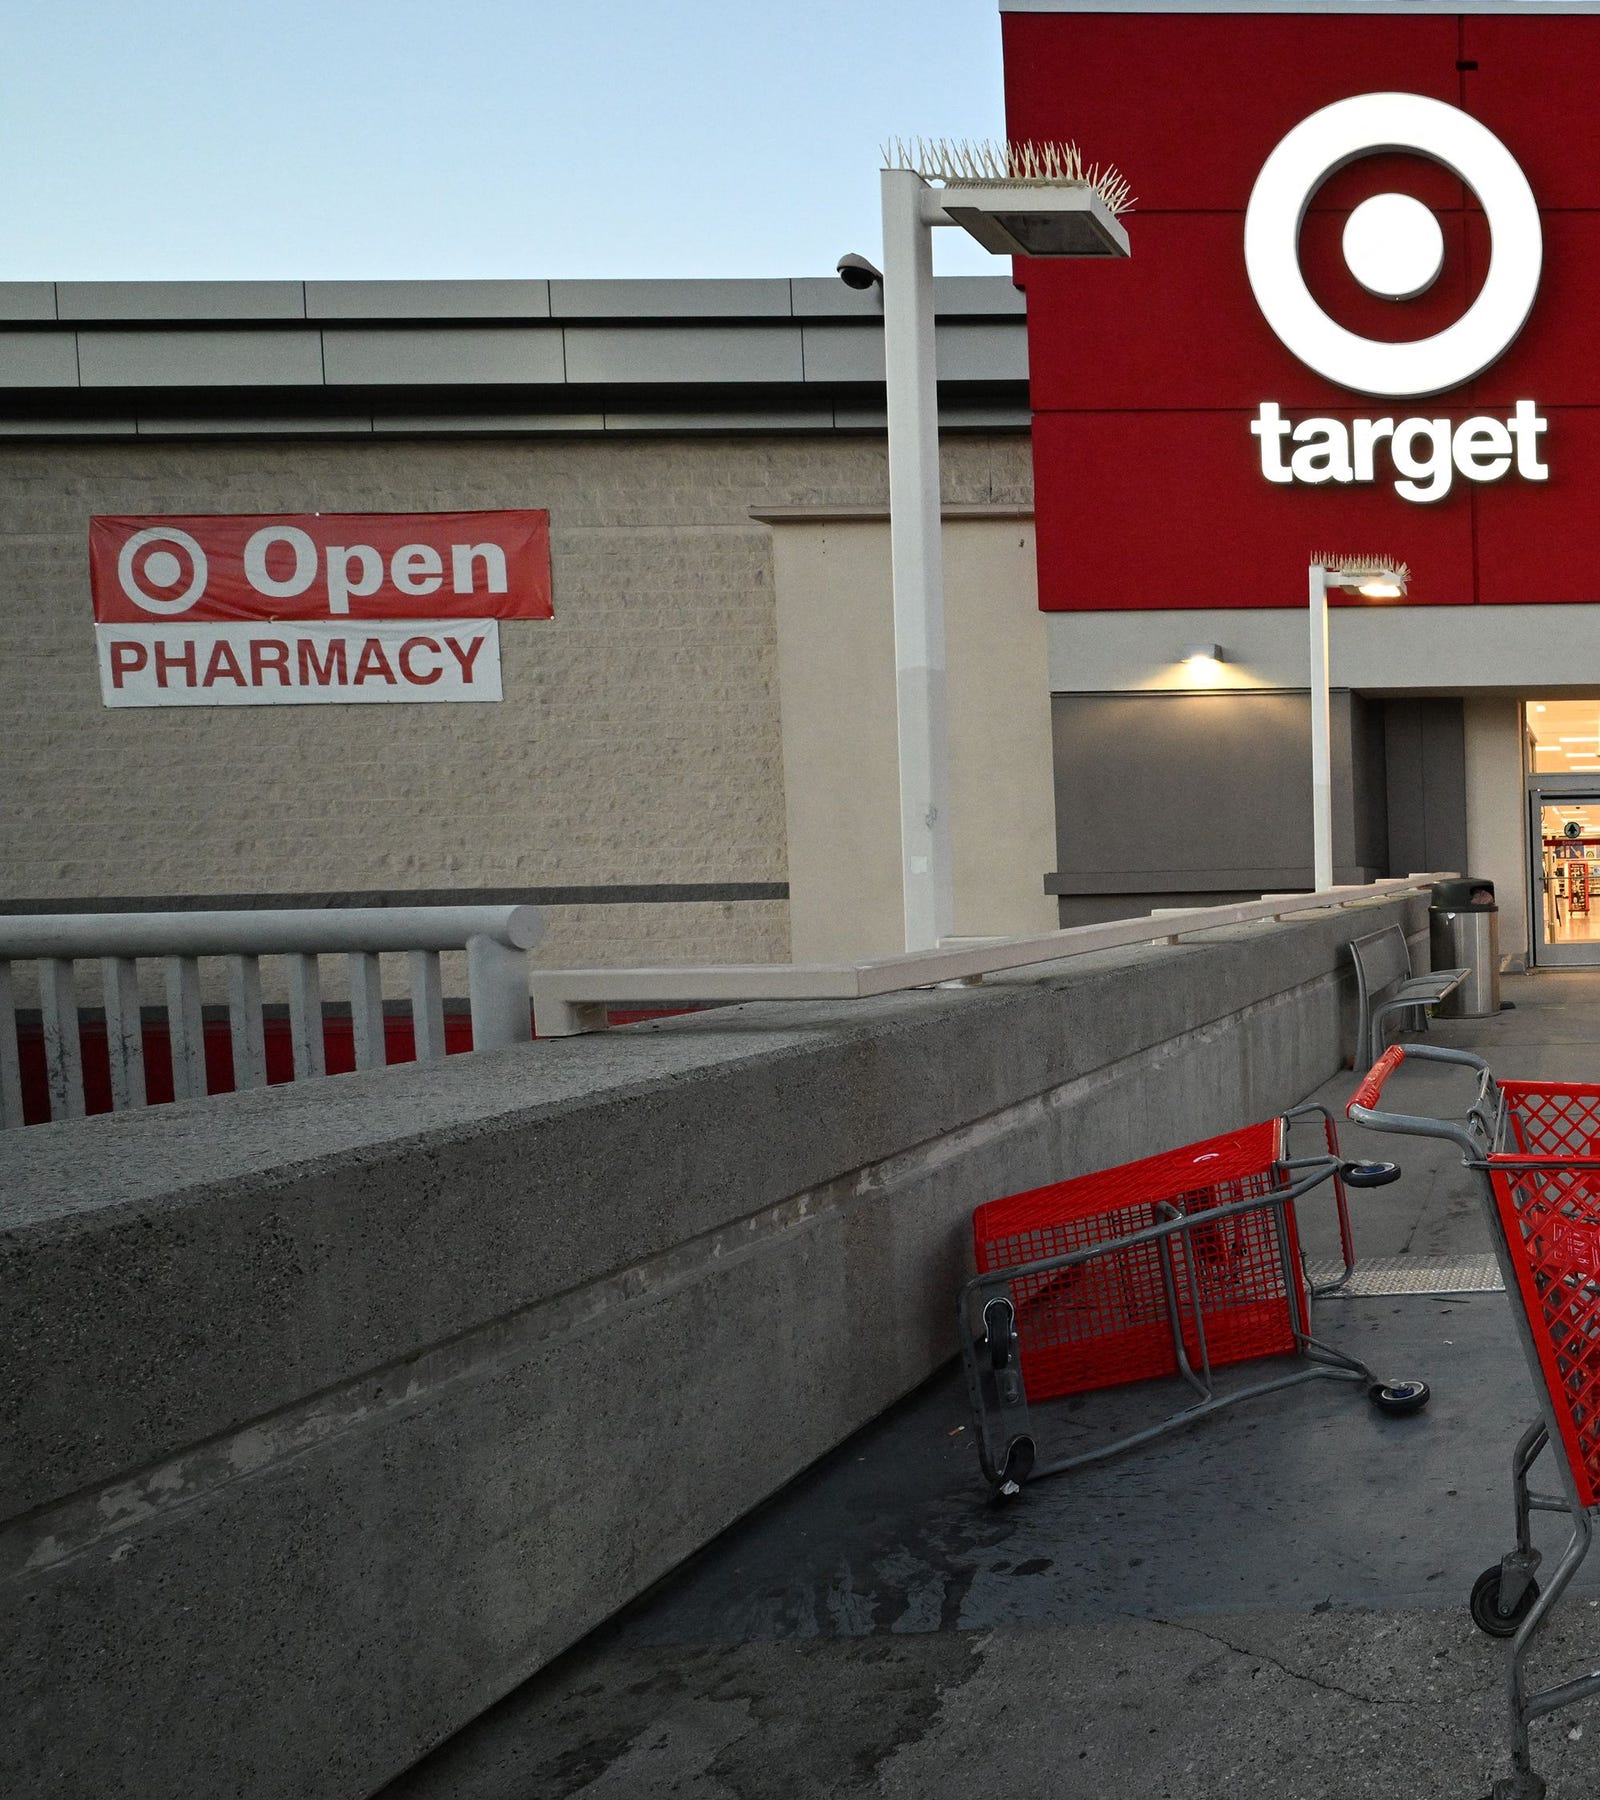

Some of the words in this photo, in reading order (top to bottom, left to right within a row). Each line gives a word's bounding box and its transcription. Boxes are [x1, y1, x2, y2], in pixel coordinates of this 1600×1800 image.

[1251, 400, 1549, 504] target
[243, 525, 509, 614] Open
[109, 635, 485, 689] PHARMACY
